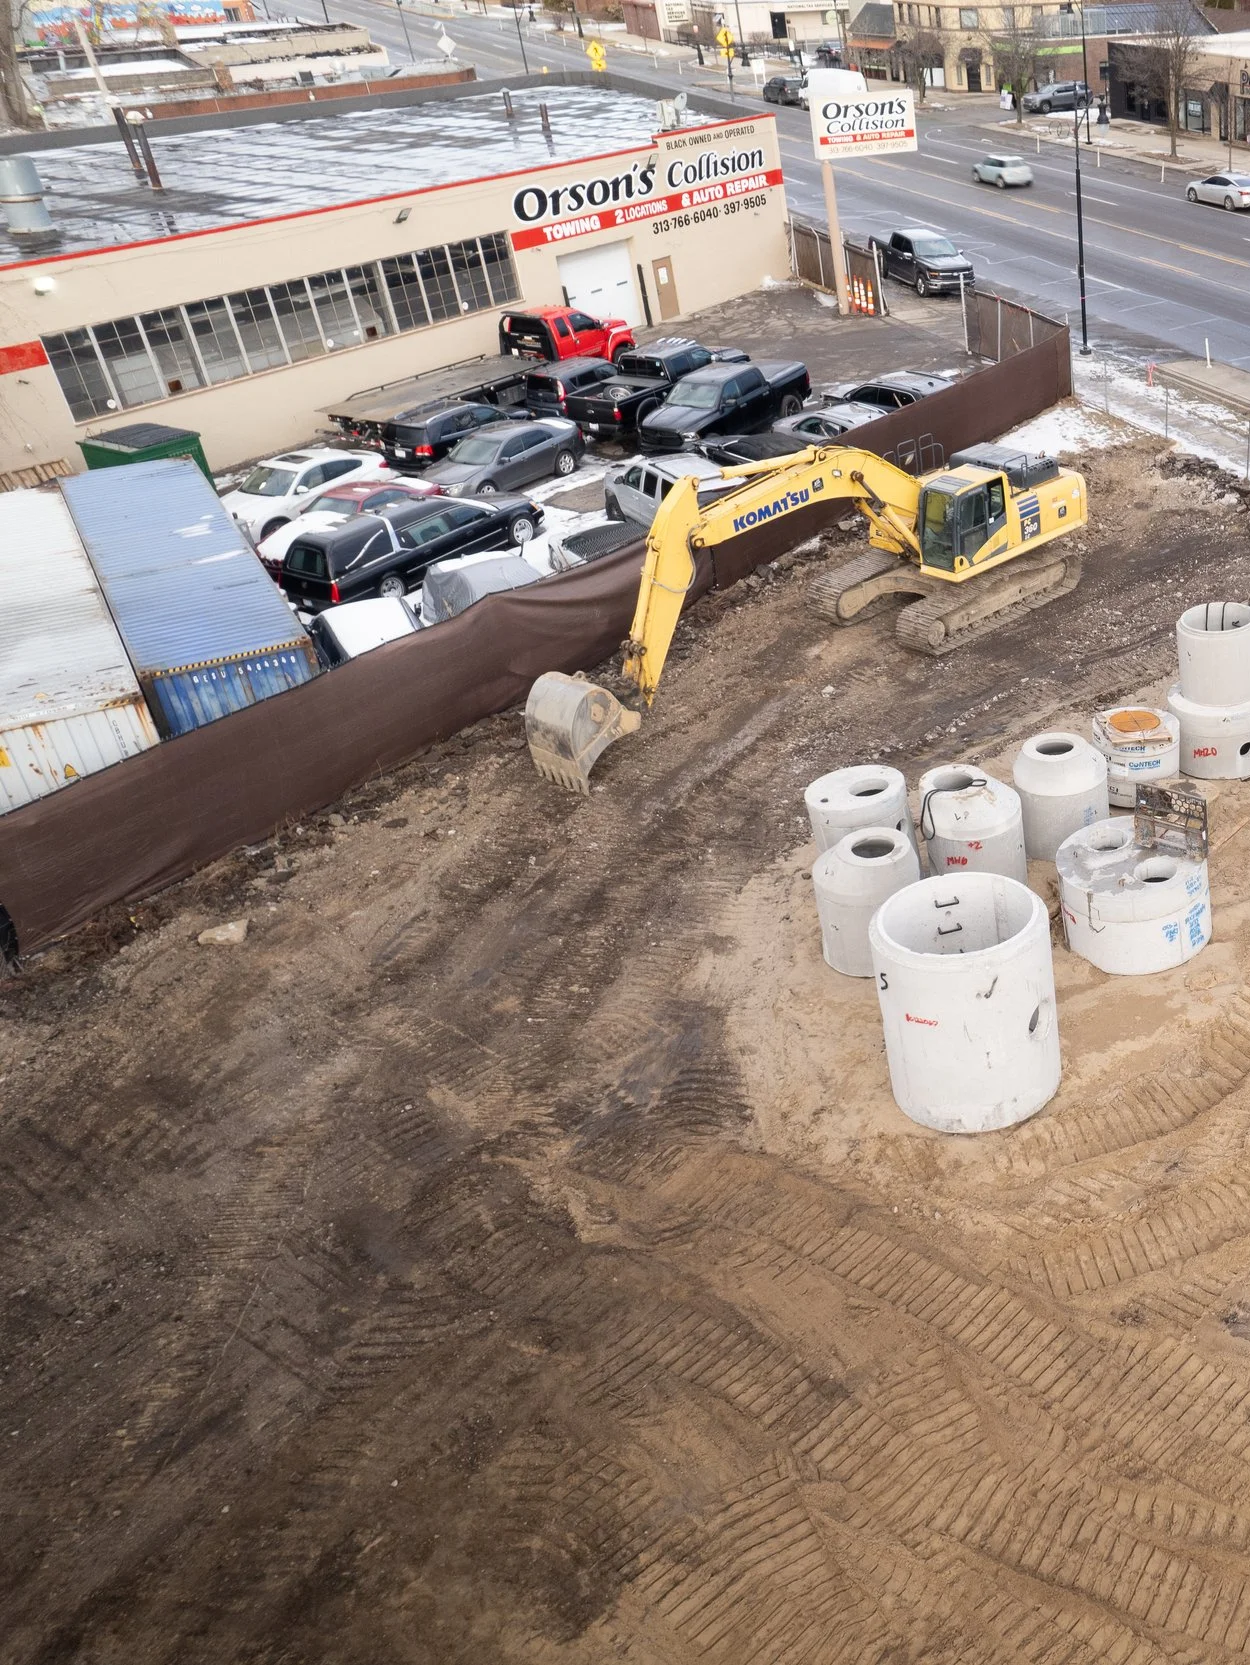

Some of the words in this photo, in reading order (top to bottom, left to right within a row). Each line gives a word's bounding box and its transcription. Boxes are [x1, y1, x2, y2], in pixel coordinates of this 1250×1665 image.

[822, 97, 907, 120] Orson's
[826, 117, 905, 134] Collision
[827, 135, 853, 143] TOWING
[863, 132, 880, 140] AUTO
[882, 130, 906, 139] REPAIR
[665, 138, 687, 151] BLACK
[688, 134, 712, 147] OWNED
[725, 125, 755, 140] OPERATED
[513, 164, 657, 222] Orson's
[667, 148, 765, 188] Collision
[543, 215, 600, 242] TOWING
[614, 209, 625, 224] 2
[625, 199, 668, 220] LOCATIONS
[681, 192, 692, 206] &
[692, 183, 724, 206] AUTO
[726, 174, 769, 197] REPAIR
[733, 488, 809, 533] KOMATSU
[1128, 759, 1161, 769] CONTECH
